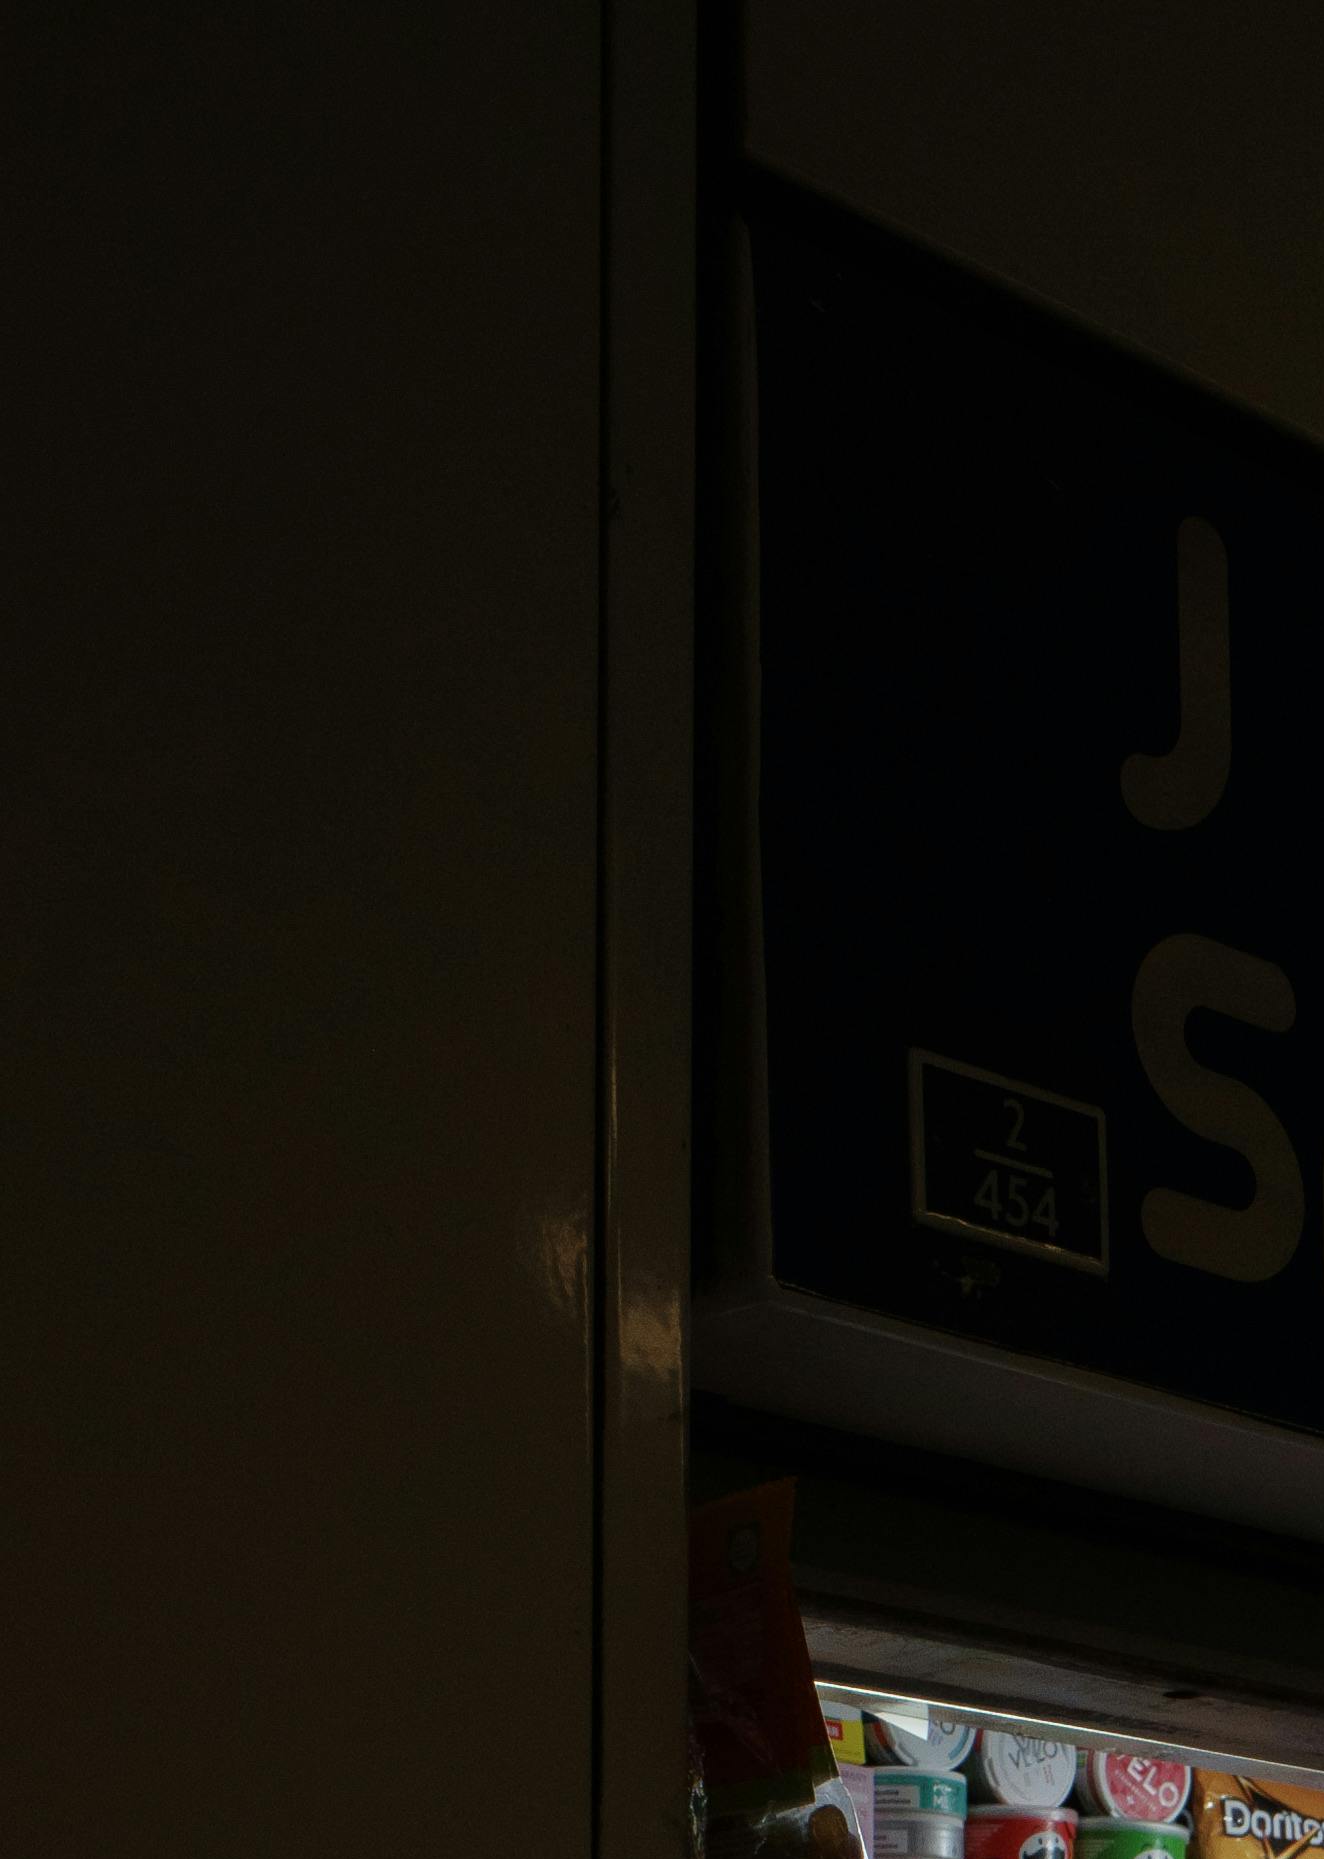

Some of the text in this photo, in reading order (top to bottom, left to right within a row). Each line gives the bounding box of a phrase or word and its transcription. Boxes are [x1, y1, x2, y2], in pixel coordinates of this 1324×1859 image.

[1119, 515, 1232, 831] J
[1001, 1097, 1027, 1151] 2
[973, 1167, 1059, 1240] 454
